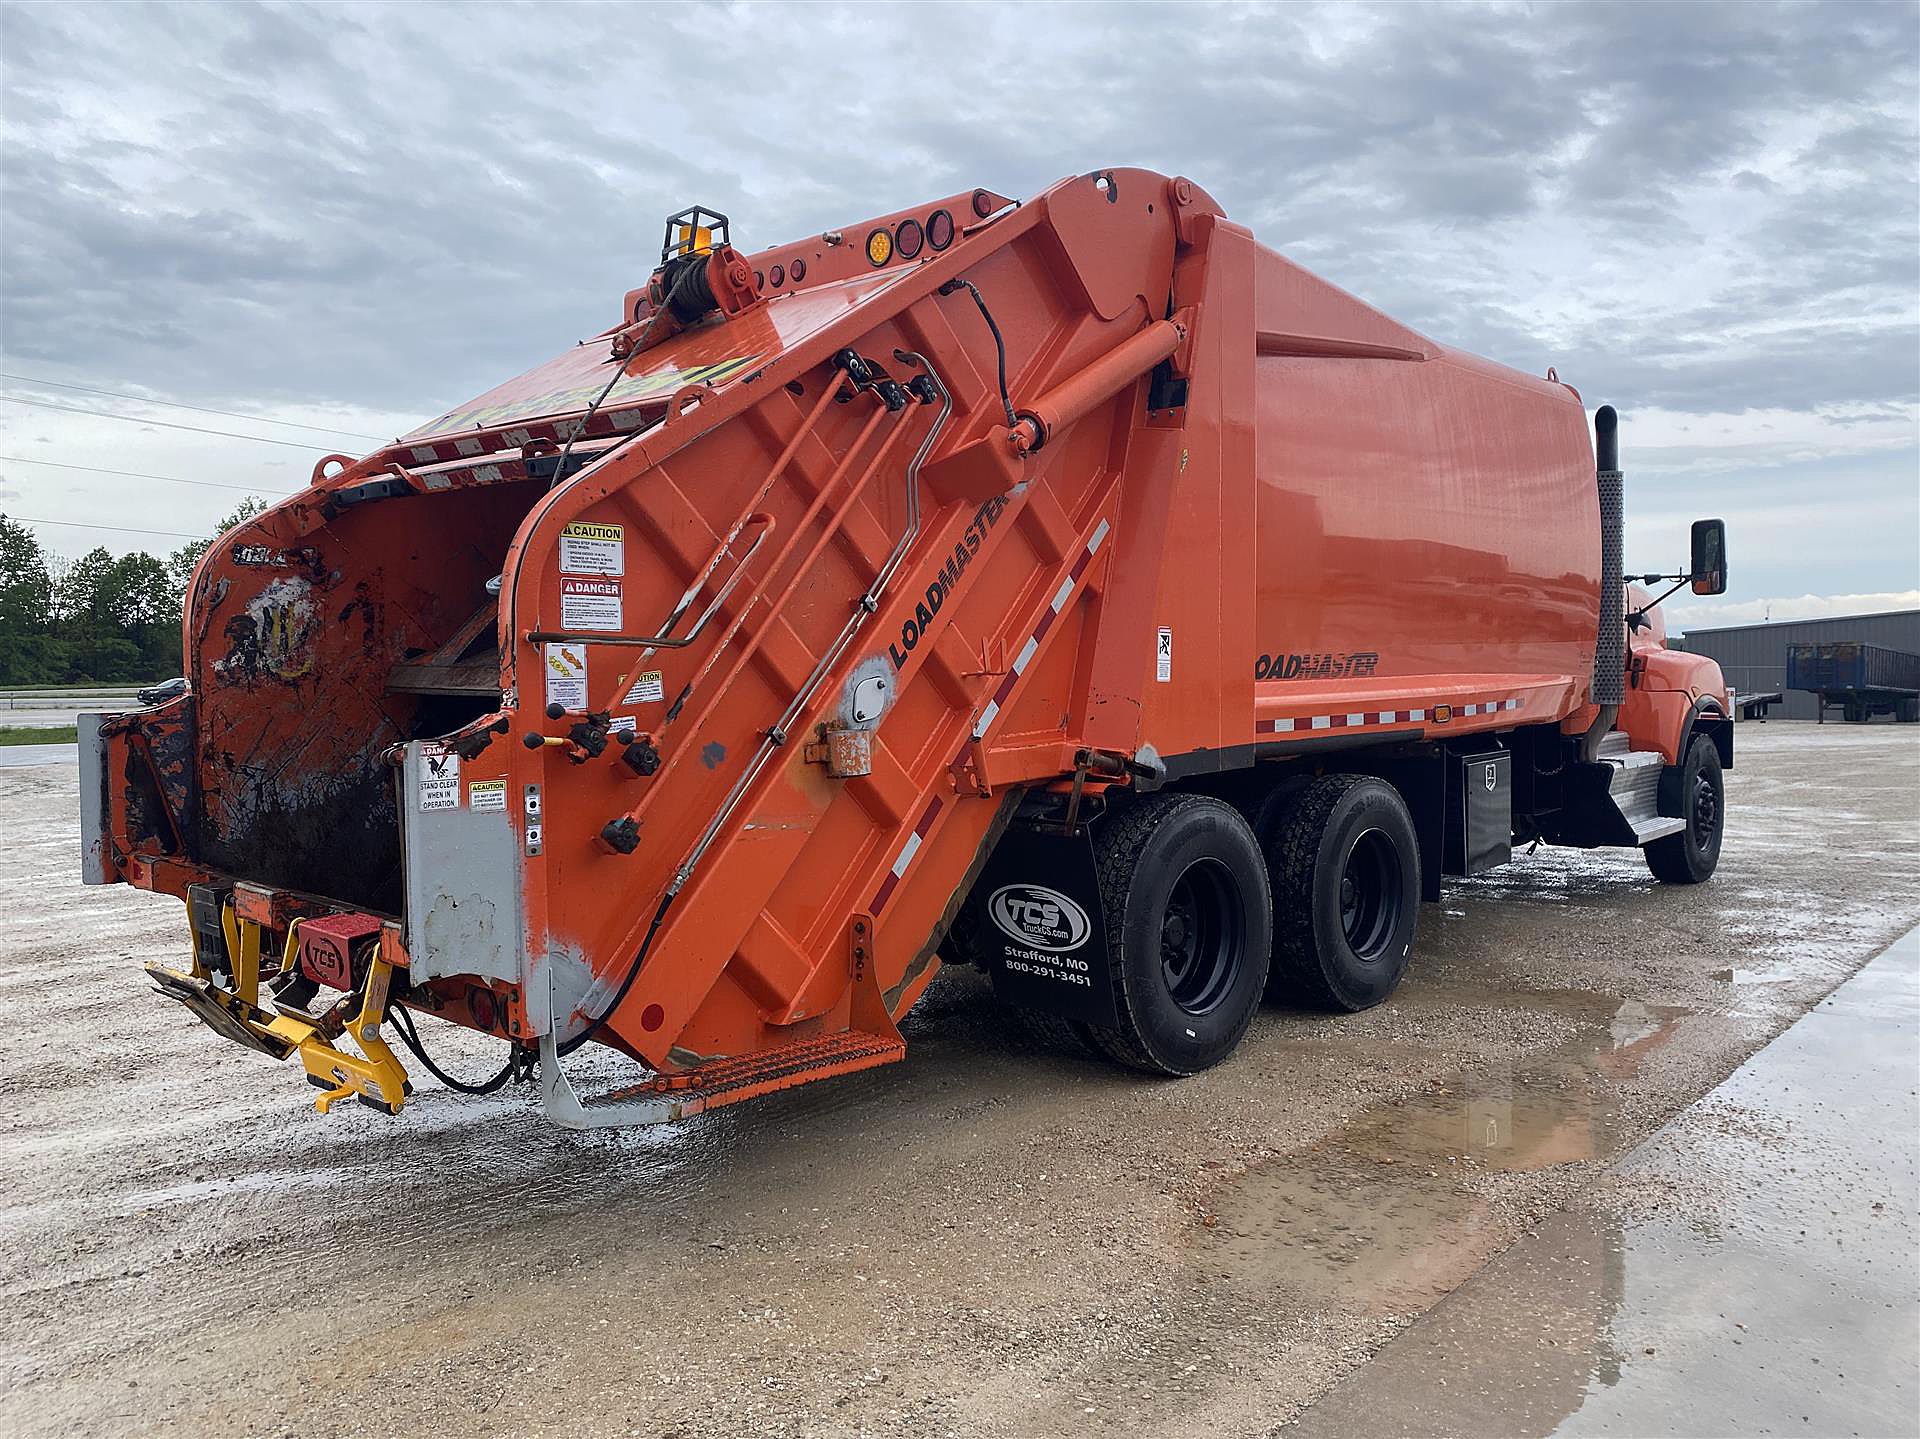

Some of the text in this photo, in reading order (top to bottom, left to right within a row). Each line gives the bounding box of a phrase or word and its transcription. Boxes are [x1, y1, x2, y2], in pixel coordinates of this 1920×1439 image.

[573, 526, 621, 539] CAUTION
[575, 583, 619, 594] DANGER
[1255, 652, 1379, 680] OADMASTER
[638, 673, 660, 682] UTION
[420, 780, 458, 791] STAND CLEAR
[477, 783, 504, 791] CAUTION
[426, 790, 451, 799] WHEN IN
[423, 800, 455, 809] OPERATION
[1007, 898, 1060, 928] TCS
[1022, 922, 1069, 939] TruckCS.com
[312, 946, 336, 969] TCS
[1004, 946, 1089, 972] Strafford, MO
[1005, 959, 1091, 987] 800-291-3451
